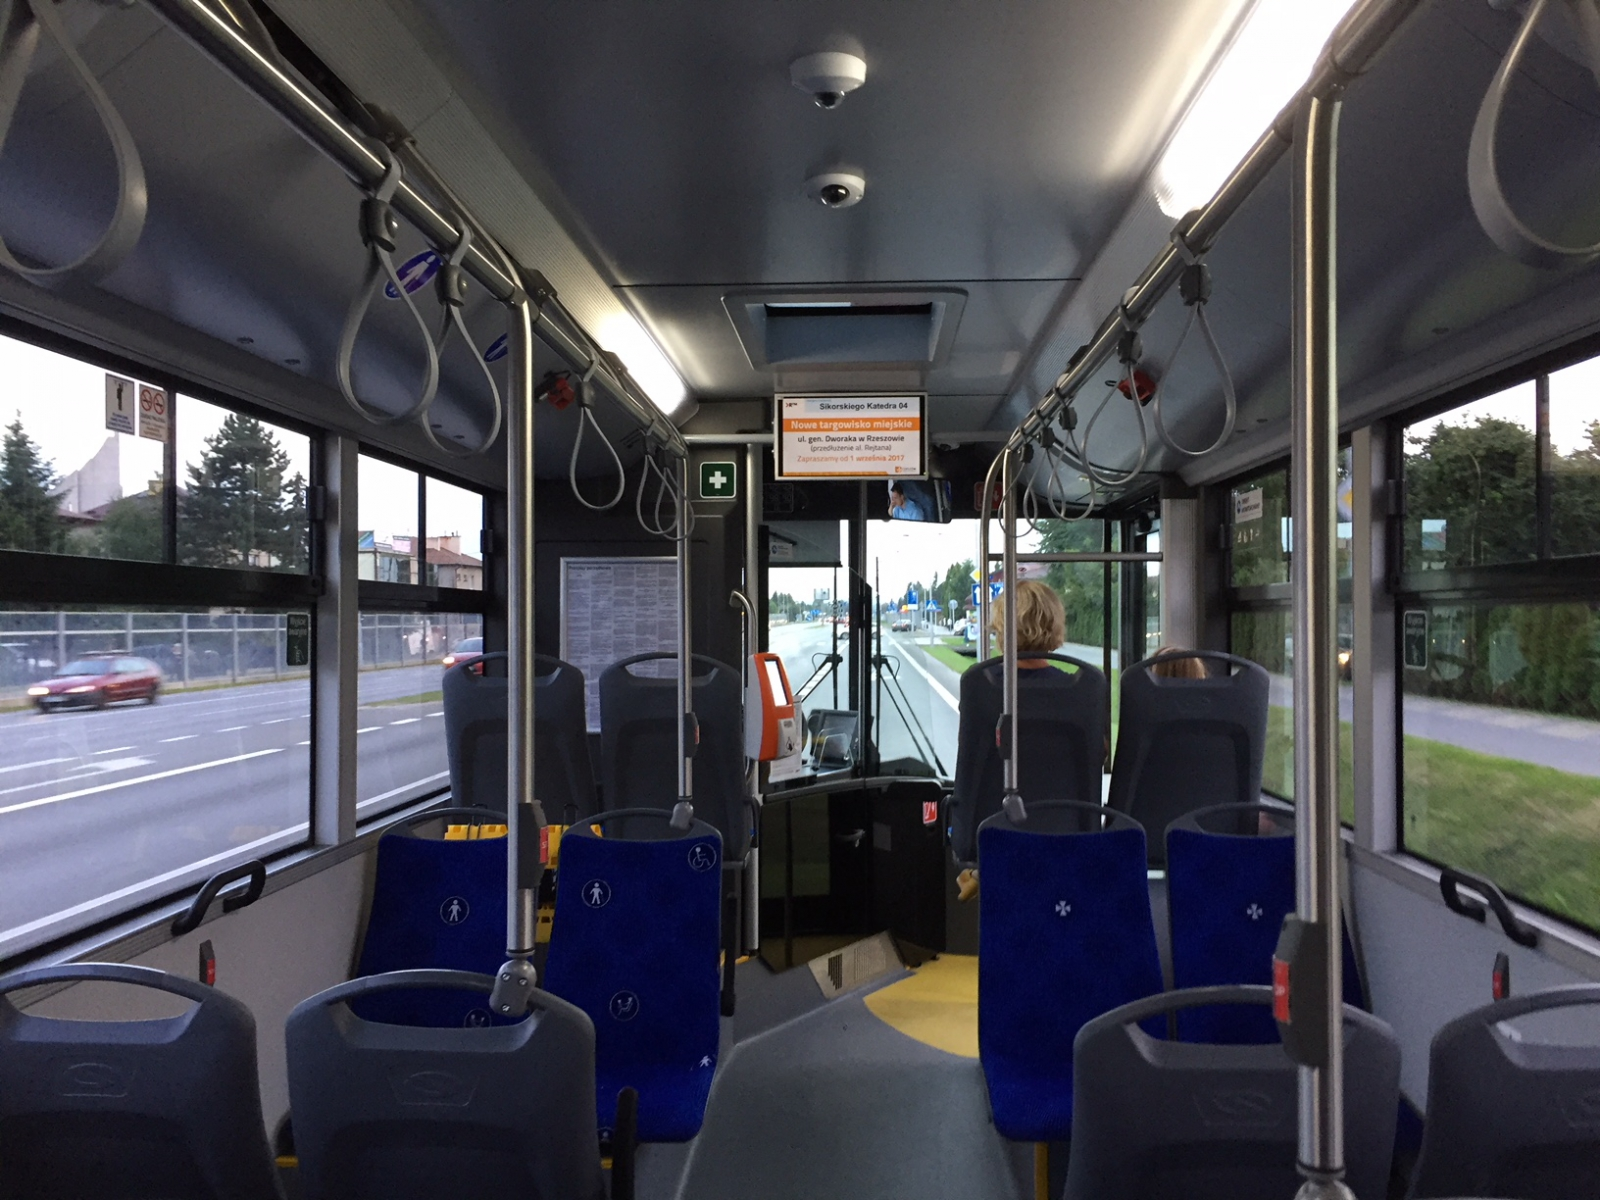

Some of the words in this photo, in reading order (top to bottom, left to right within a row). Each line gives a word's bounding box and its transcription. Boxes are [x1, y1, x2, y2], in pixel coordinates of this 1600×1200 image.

[819, 402, 865, 411] Sikorskiego
[791, 420, 818, 429] Nowe
[819, 420, 871, 431] targowisko
[873, 419, 913, 430] miejskie
[808, 436, 823, 444] gen.
[825, 434, 857, 442] Dworaka
[866, 434, 905, 442] Rzeszowie
[864, 444, 892, 452] Rejtana)
[797, 455, 838, 463] Zapraszamy
[856, 454, 887, 462] września
